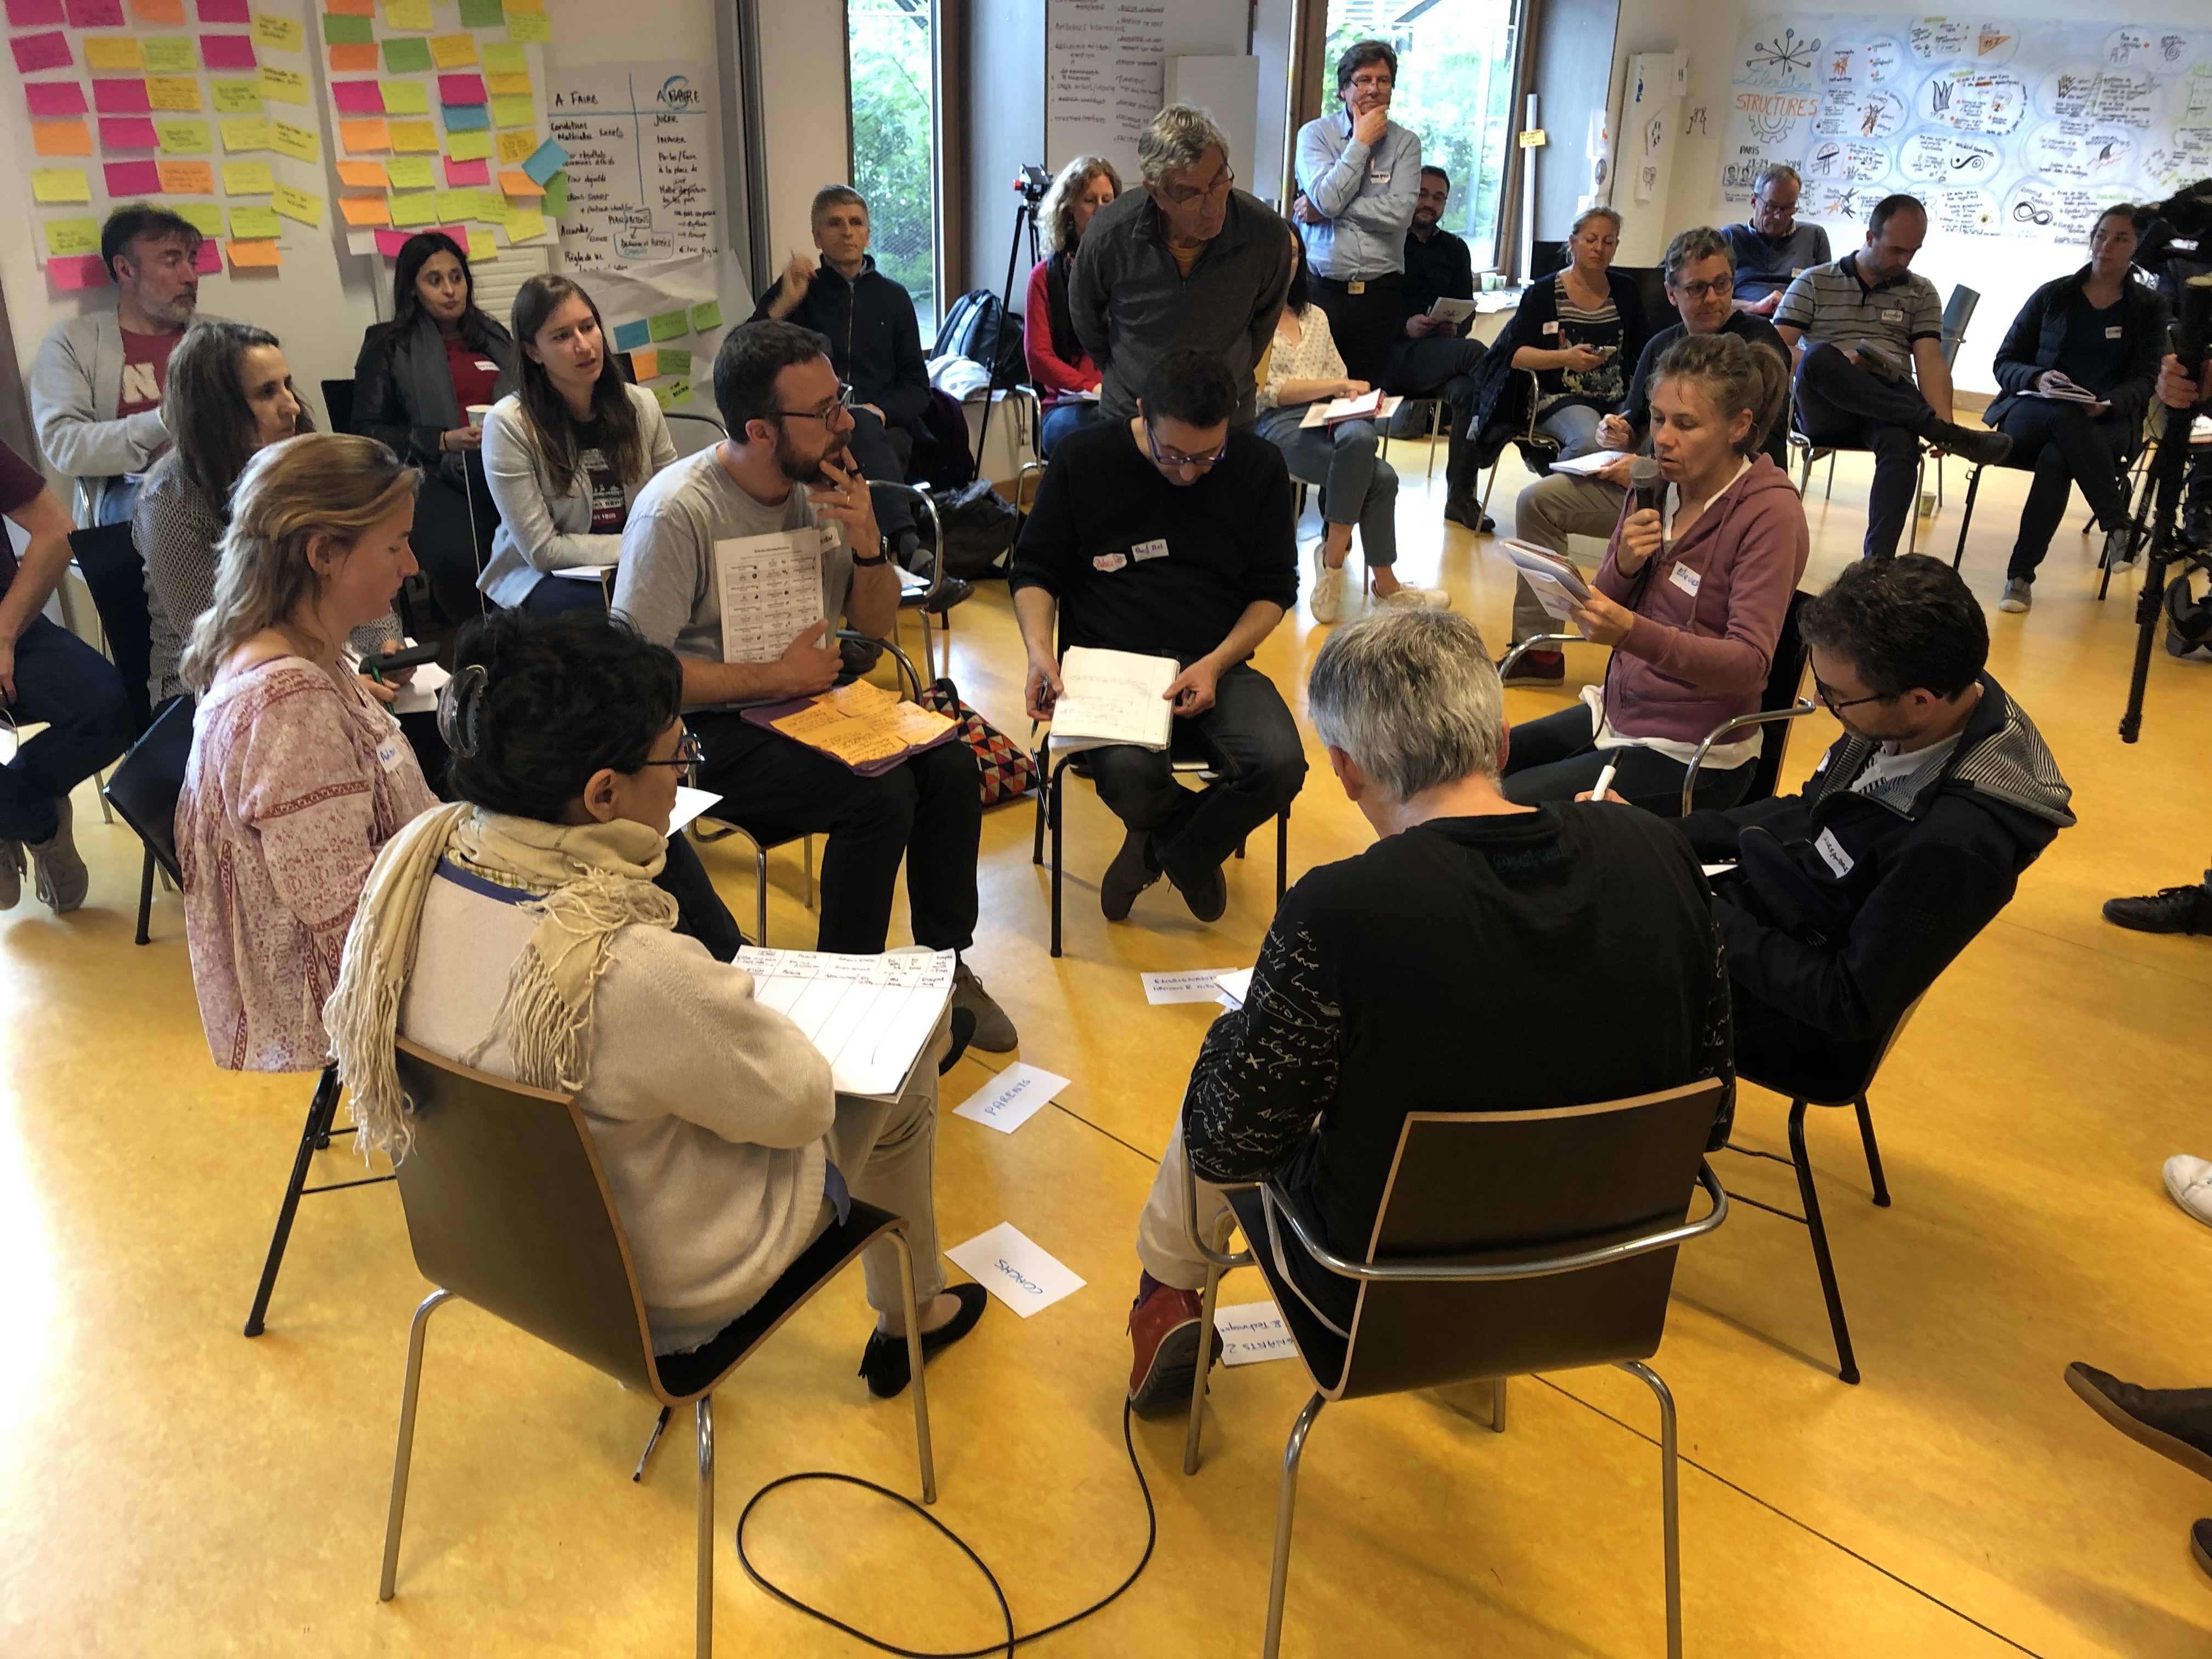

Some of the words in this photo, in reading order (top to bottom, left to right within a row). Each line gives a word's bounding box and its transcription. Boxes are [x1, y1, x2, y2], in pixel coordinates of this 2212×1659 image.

[1732, 65, 1812, 94] Liberating
[1735, 92, 1819, 117] STRUCTURES
[1740, 144, 1760, 155] PARIS
[1785, 158, 1802, 172] 2019
[984, 1079, 1031, 1116] PARENTS
